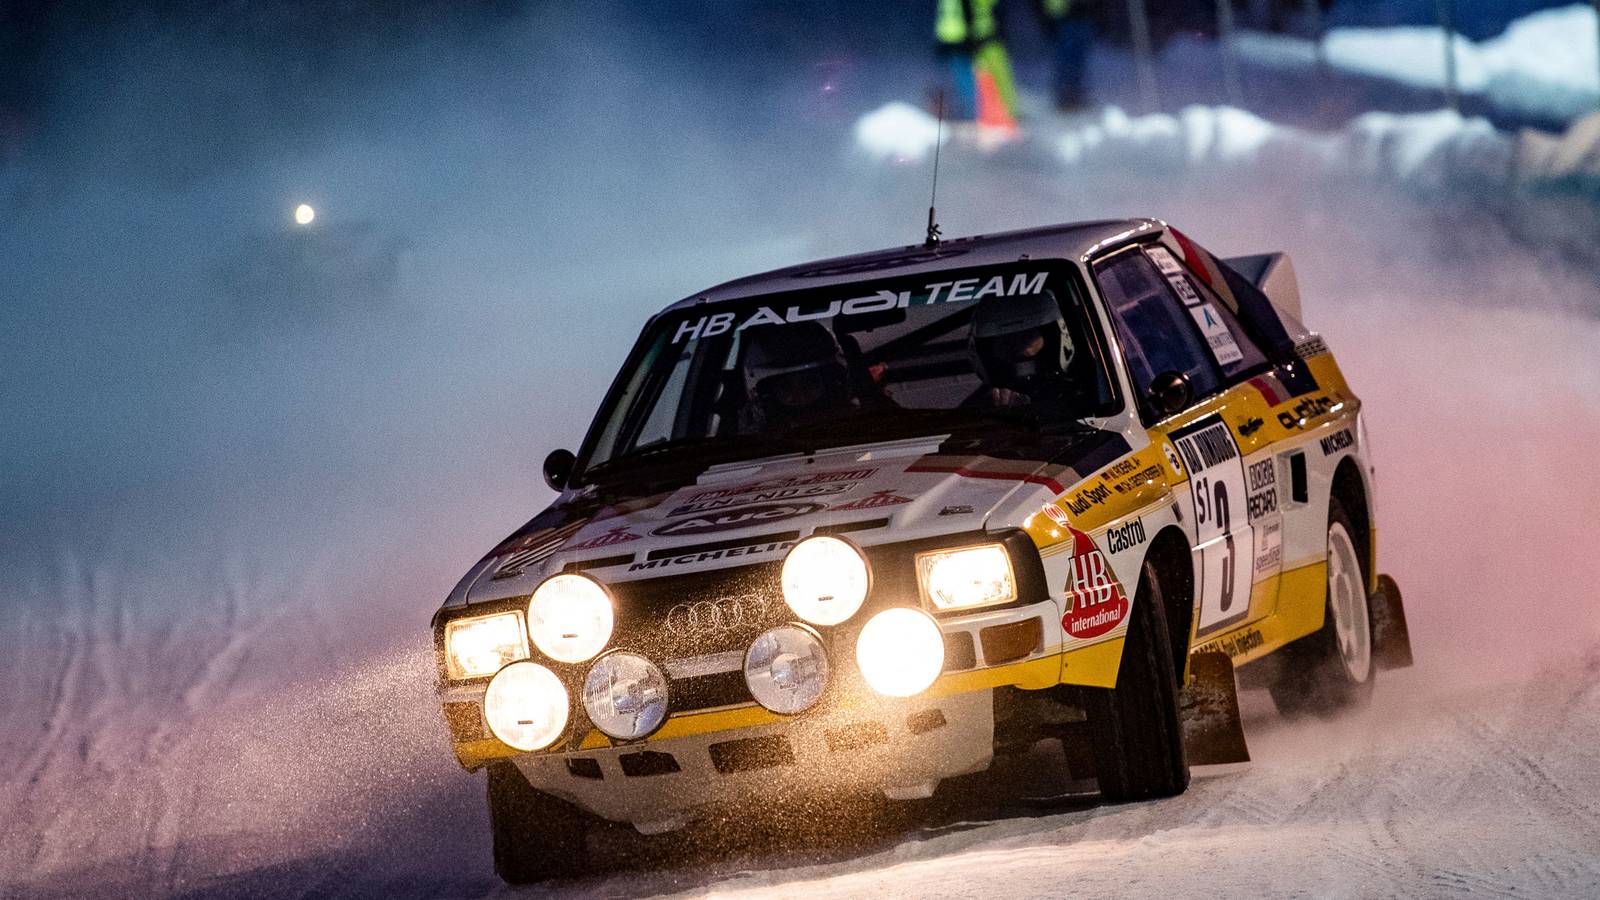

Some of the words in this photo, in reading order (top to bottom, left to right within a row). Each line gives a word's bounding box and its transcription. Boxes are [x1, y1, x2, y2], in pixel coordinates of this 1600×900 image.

[672, 312, 736, 344] HB
[925, 272, 1049, 304] TEAM
[1178, 438, 1203, 474] BAD
[1320, 428, 1354, 456] MICHELIN
[1065, 493, 1091, 517] Audi
[1083, 481, 1112, 505] Sport
[1249, 487, 1278, 519] RECARO
[1107, 516, 1146, 555] Castrol
[1214, 480, 1235, 612] 3
[1068, 548, 1112, 609] HB
[1072, 604, 1121, 633] international
